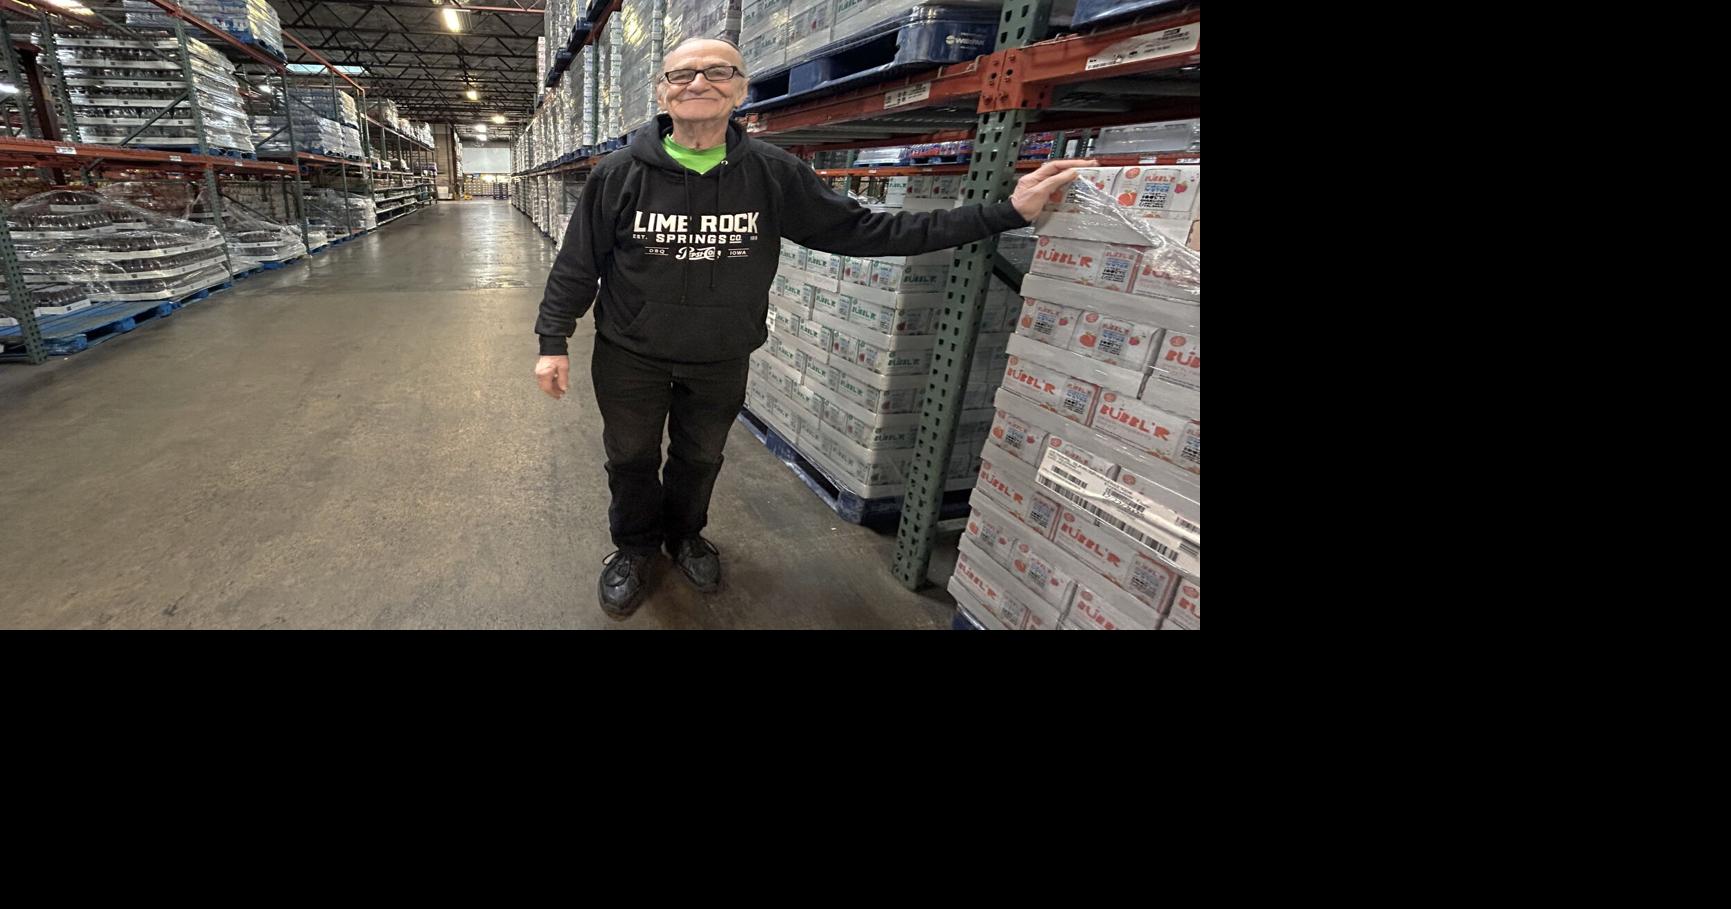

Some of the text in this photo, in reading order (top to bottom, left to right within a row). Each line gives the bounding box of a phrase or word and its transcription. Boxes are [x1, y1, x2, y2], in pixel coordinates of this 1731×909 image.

[634, 211, 760, 234] LIME ROCK
[656, 234, 727, 244] SPRINGS
